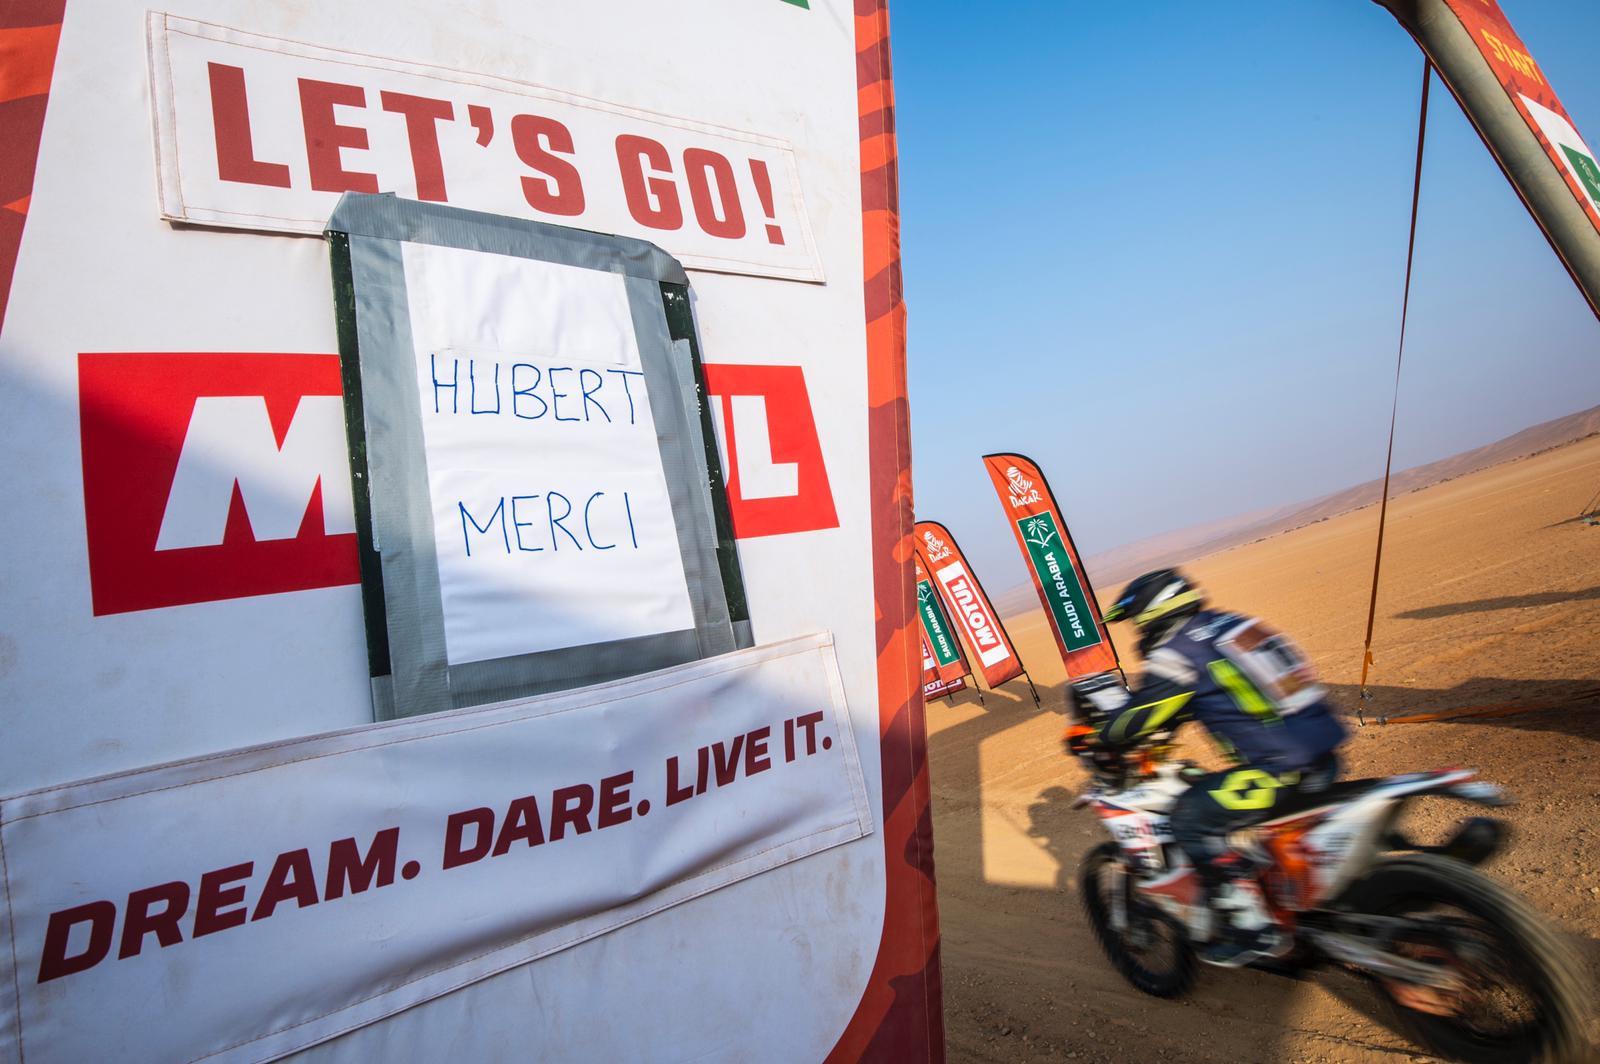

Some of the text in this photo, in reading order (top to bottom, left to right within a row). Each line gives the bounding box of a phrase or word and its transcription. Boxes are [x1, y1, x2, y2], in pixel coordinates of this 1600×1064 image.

[615, 133, 785, 246] GO!
[430, 354, 645, 425] HUBERT
[458, 491, 639, 558] MERCI
[925, 604, 942, 634] ARABIA
[951, 578, 997, 647] MOTUL
[1043, 551, 1085, 638] SAUDI ARABIA
[937, 633, 952, 658] SAUDI
[37, 710, 833, 982] DREAM. DARE. LIVE IT.
